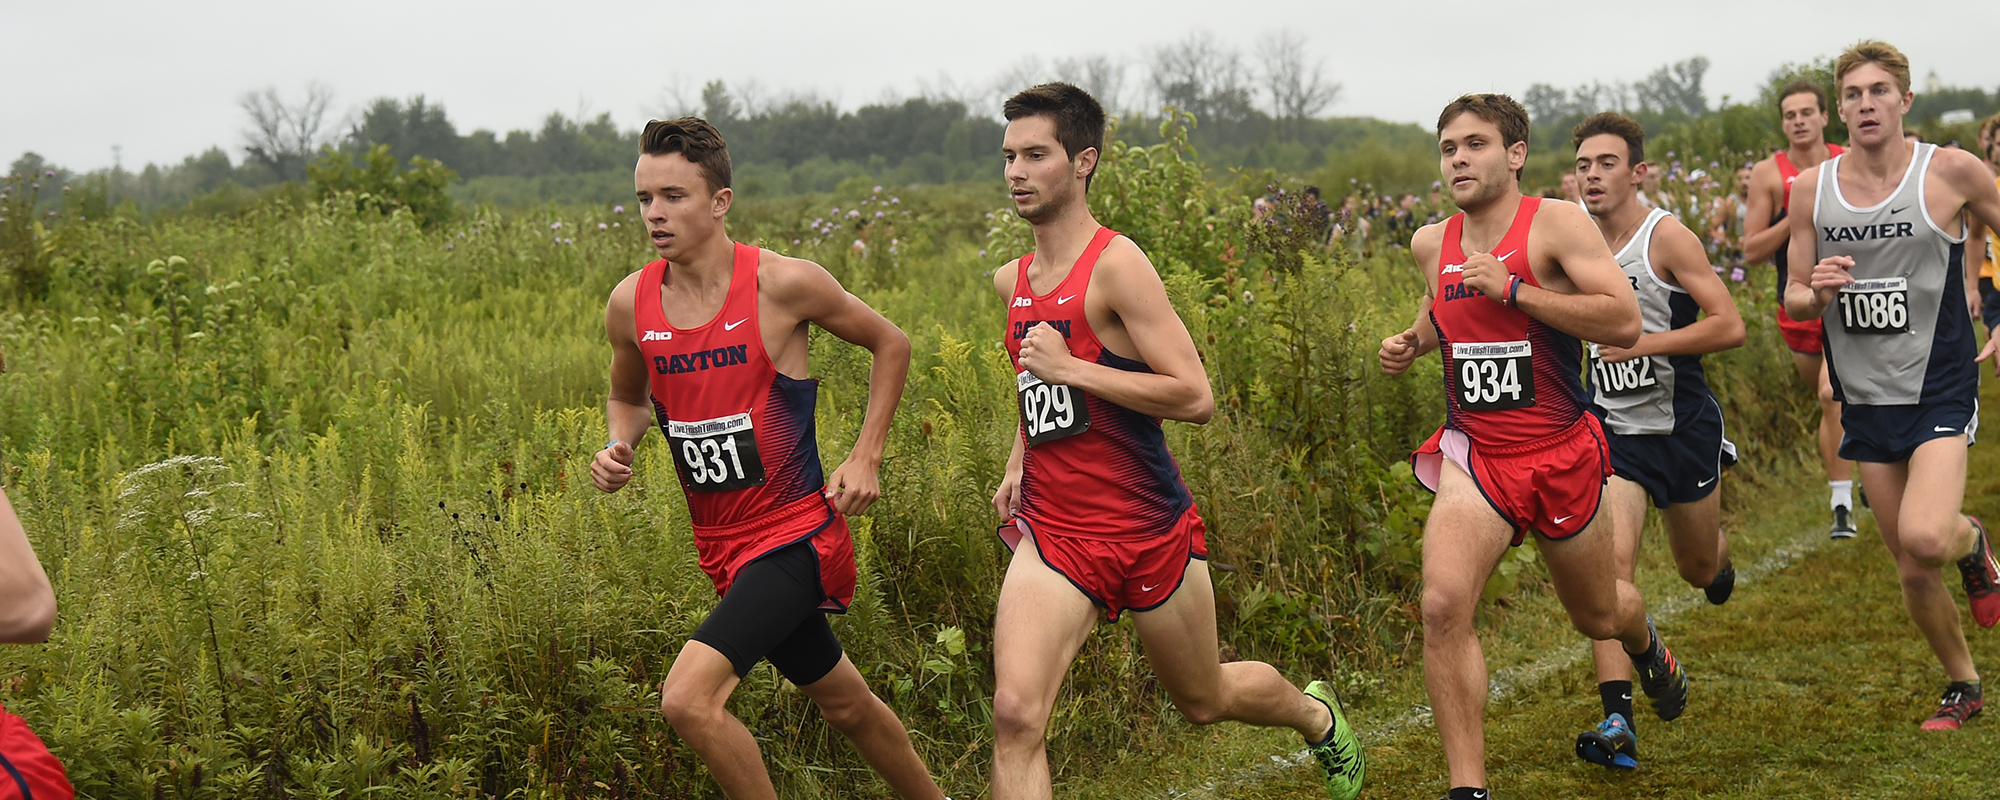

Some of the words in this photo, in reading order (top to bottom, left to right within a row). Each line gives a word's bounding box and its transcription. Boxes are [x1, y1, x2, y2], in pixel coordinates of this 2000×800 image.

[1823, 222, 1914, 241] XAVIER
[1840, 292, 1907, 329] 1086
[641, 330, 672, 341] A10
[654, 344, 748, 375] DAYTON
[1596, 356, 1655, 392] 1082
[1462, 358, 1522, 403] 934
[1025, 384, 1074, 437] 929
[682, 435, 745, 484] 931
